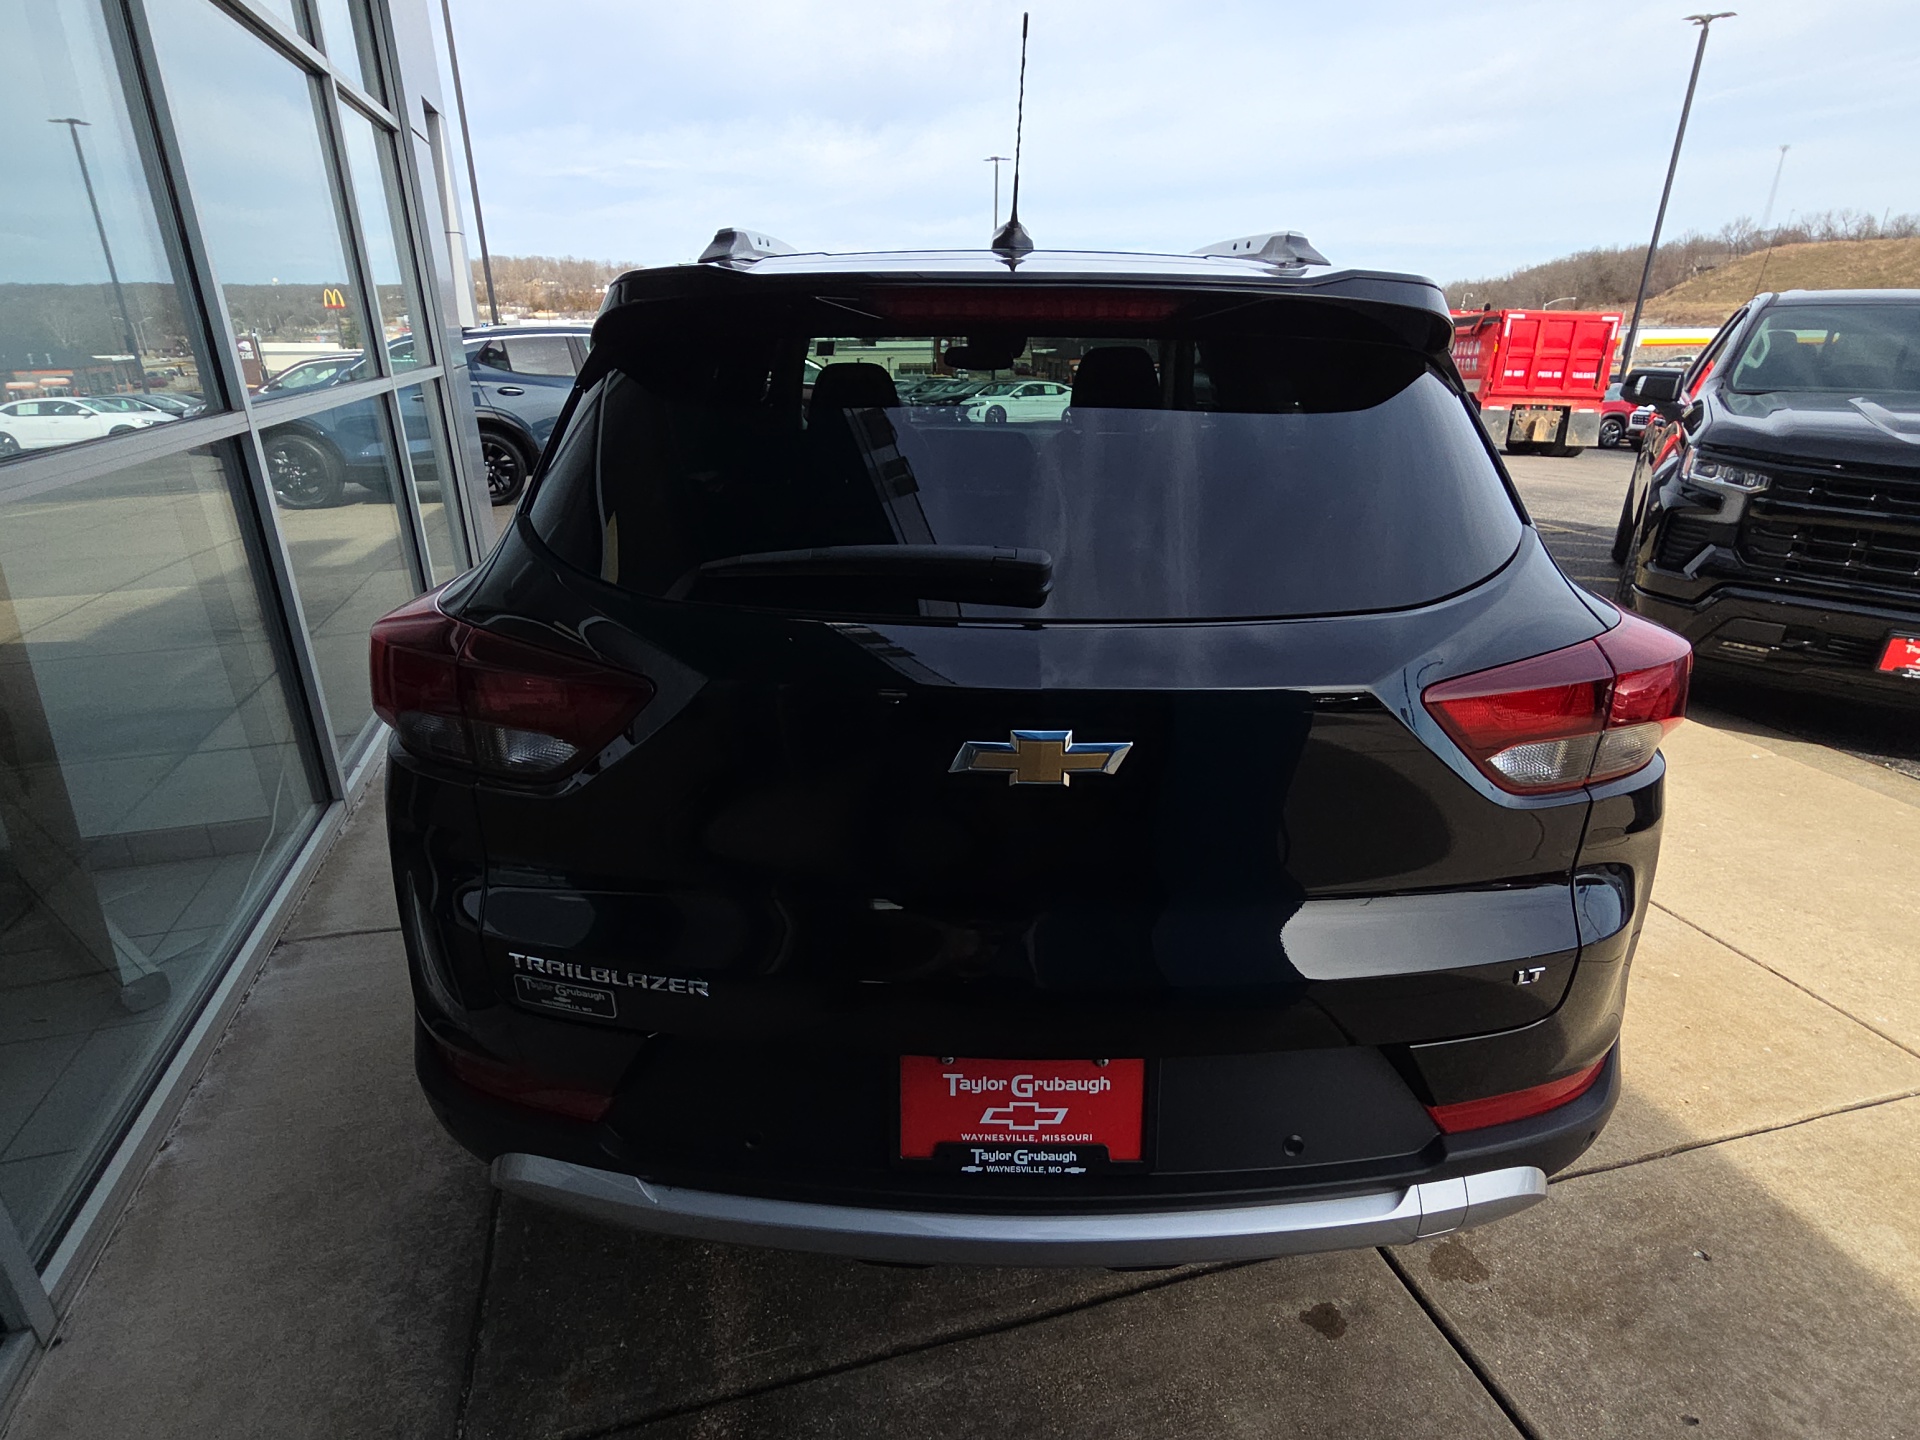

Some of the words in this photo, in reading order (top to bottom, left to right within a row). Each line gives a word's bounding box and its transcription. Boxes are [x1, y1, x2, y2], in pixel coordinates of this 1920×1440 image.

[508, 952, 709, 997] TRAILBLAZER
[1514, 966, 1546, 986] LT
[555, 984, 606, 1001] Grubaugh
[943, 1073, 1007, 1097] Taylor
[1011, 1074, 1111, 1098] Grubaugh
[961, 1133, 1039, 1143] WAYNESVILLE,
[1041, 1133, 1093, 1142] MISSOURI
[970, 1148, 1012, 1164] Taylor
[1013, 1149, 1077, 1165] Grubaugh
[986, 1165, 1046, 1174] WAYNESVILLE,
[1048, 1165, 1062, 1174] MO
